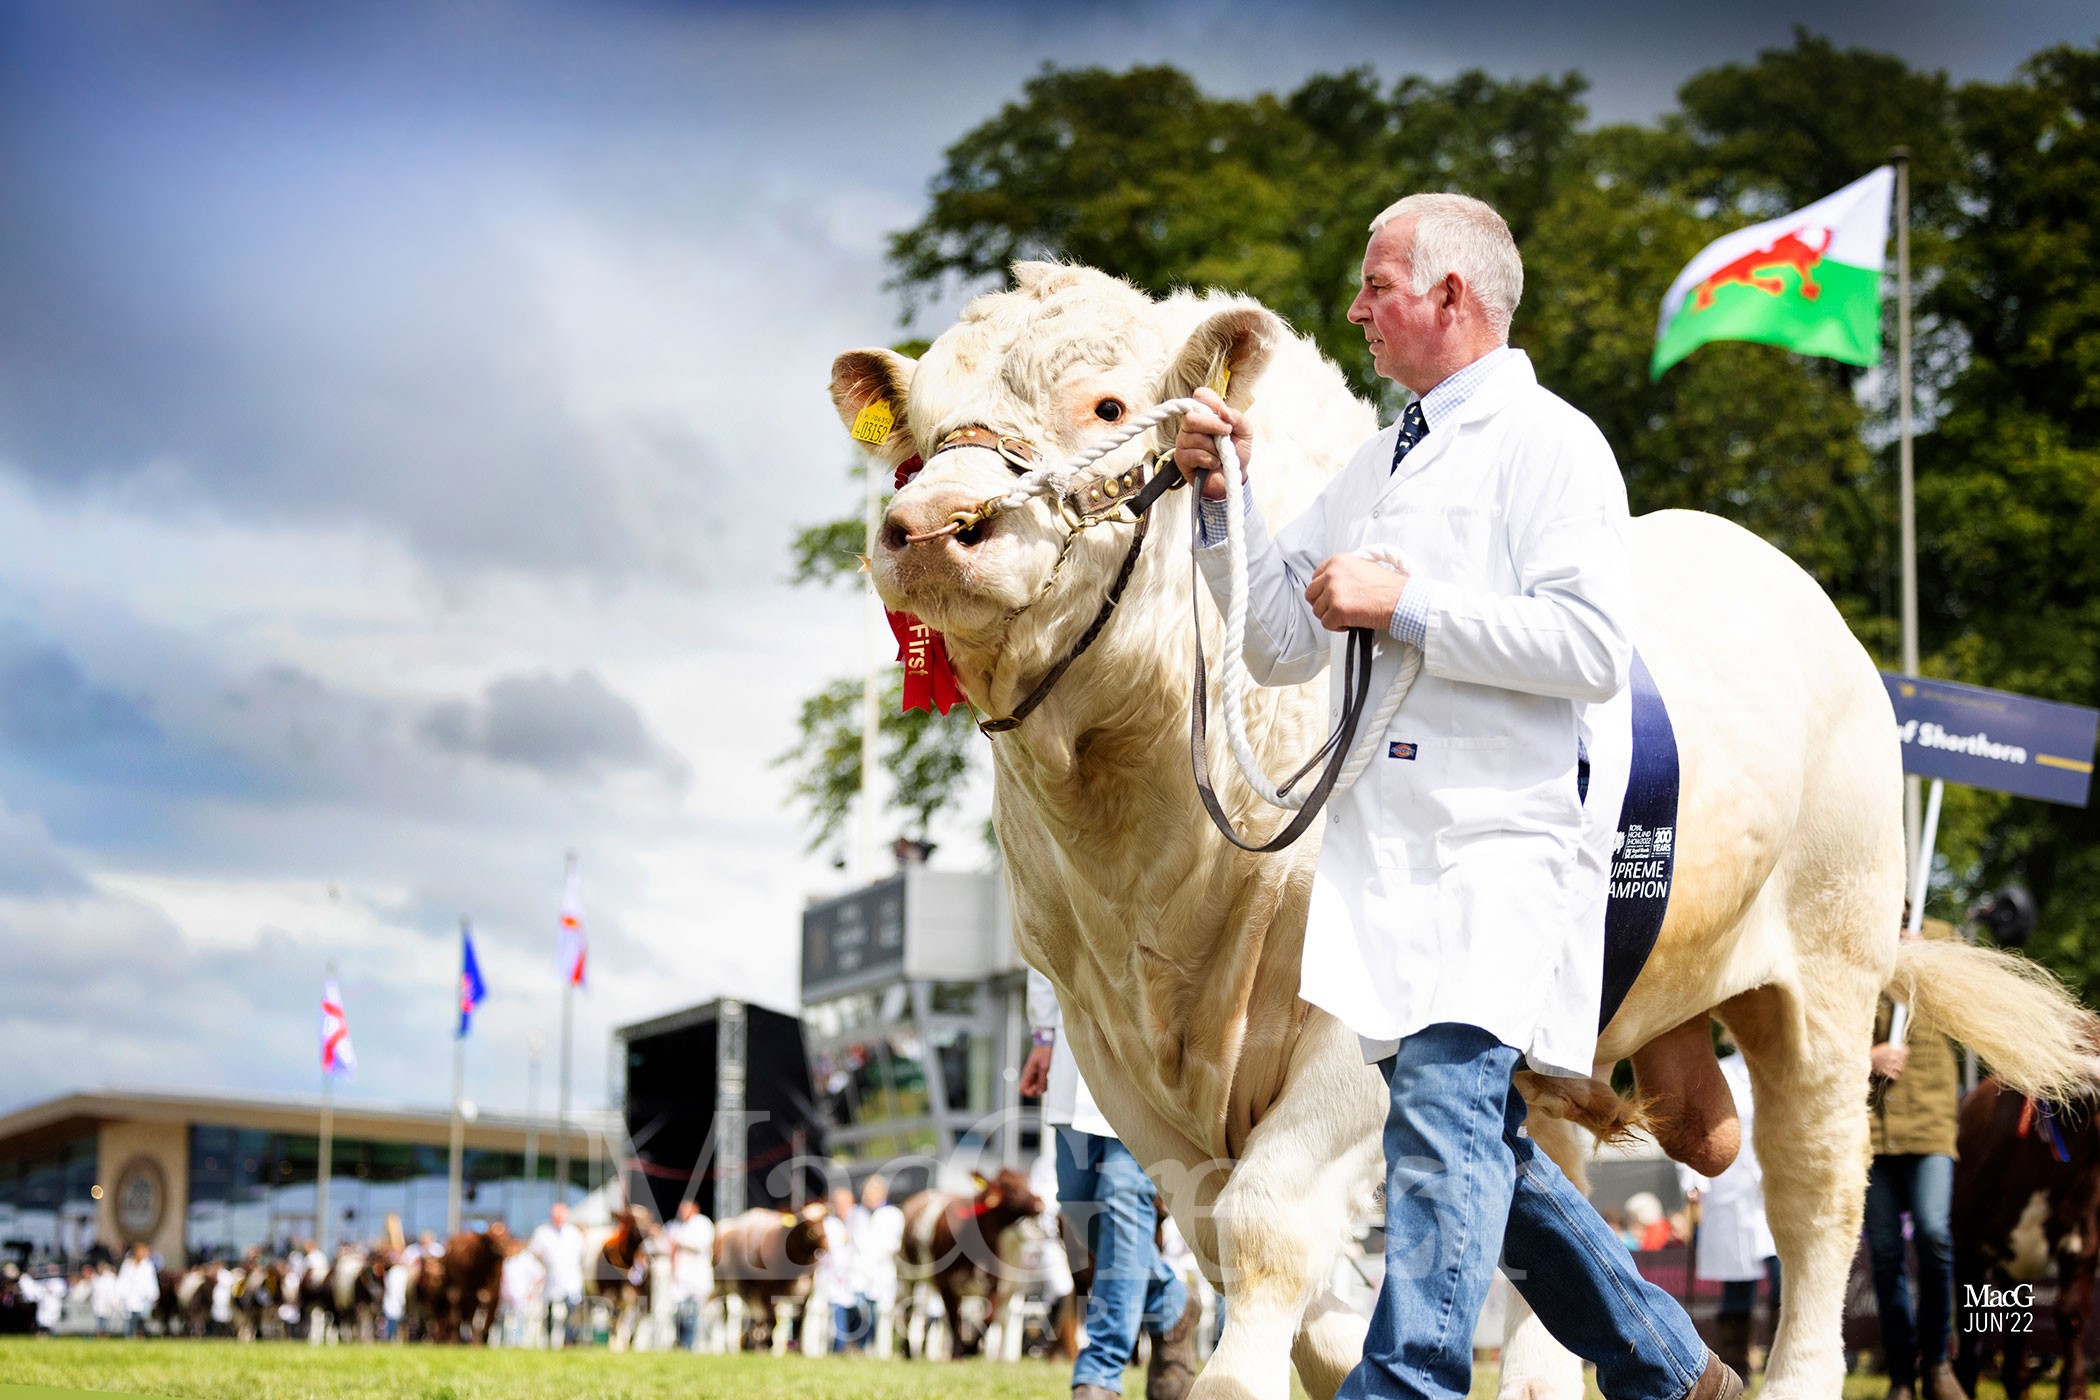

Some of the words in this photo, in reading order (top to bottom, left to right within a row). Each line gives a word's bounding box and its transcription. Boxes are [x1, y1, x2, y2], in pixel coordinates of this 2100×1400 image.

[908, 624, 930, 676] First
[1917, 722, 2028, 765] Shorthorn
[1654, 830, 1673, 844] 200
[1653, 843, 1672, 852] YEARS
[1610, 860, 1665, 879] UPREME
[1608, 880, 1668, 899] AMPION
